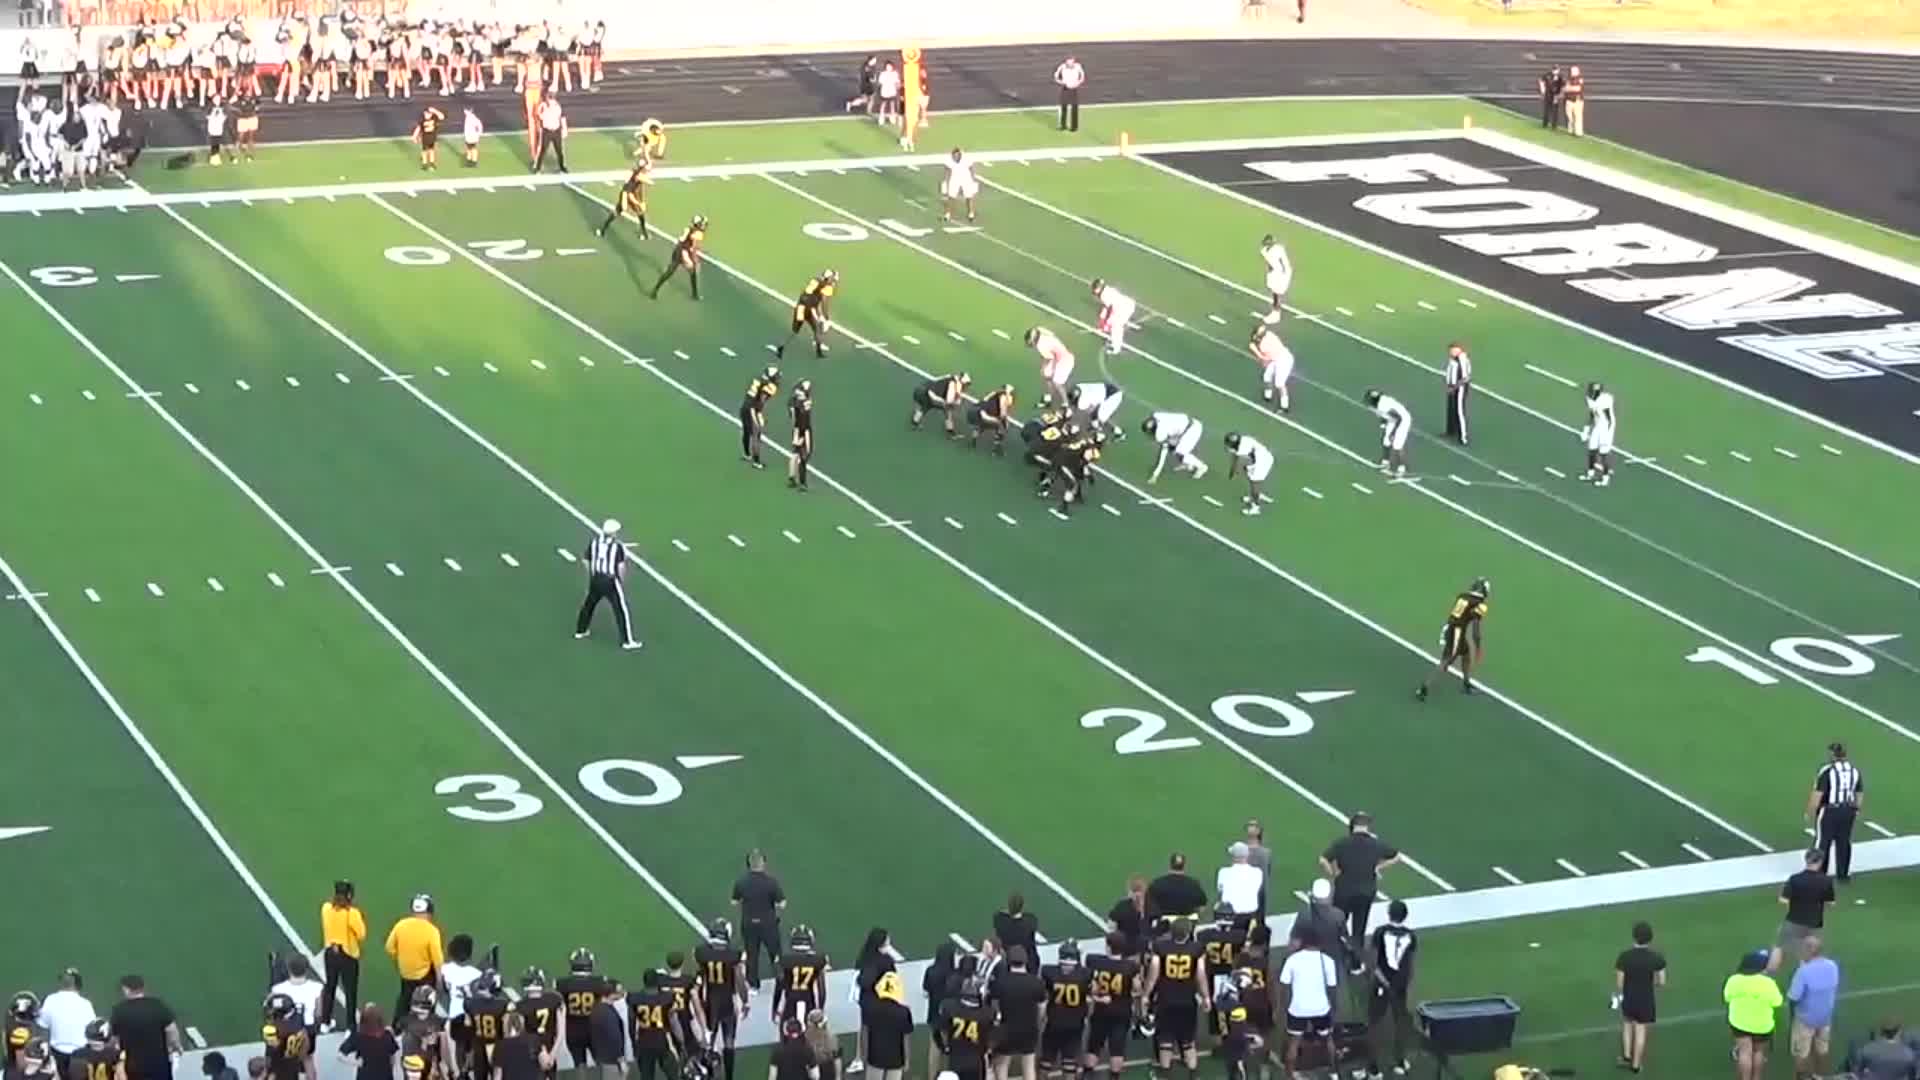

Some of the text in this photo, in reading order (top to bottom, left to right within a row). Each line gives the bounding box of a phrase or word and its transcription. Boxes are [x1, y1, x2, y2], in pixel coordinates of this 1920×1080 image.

[1685, 637, 1875, 686] 10
[1080, 694, 1314, 754] 20
[434, 756, 682, 822] 30
[707, 961, 724, 984] 11
[791, 966, 815, 991] 17
[1164, 954, 1191, 979] 62
[567, 991, 594, 1015] 28
[1053, 983, 1080, 1007] 70
[473, 1014, 496, 1040] 18
[536, 1007, 549, 1034] 7
[636, 1005, 663, 1028] 34
[952, 1017, 979, 1041] 74
